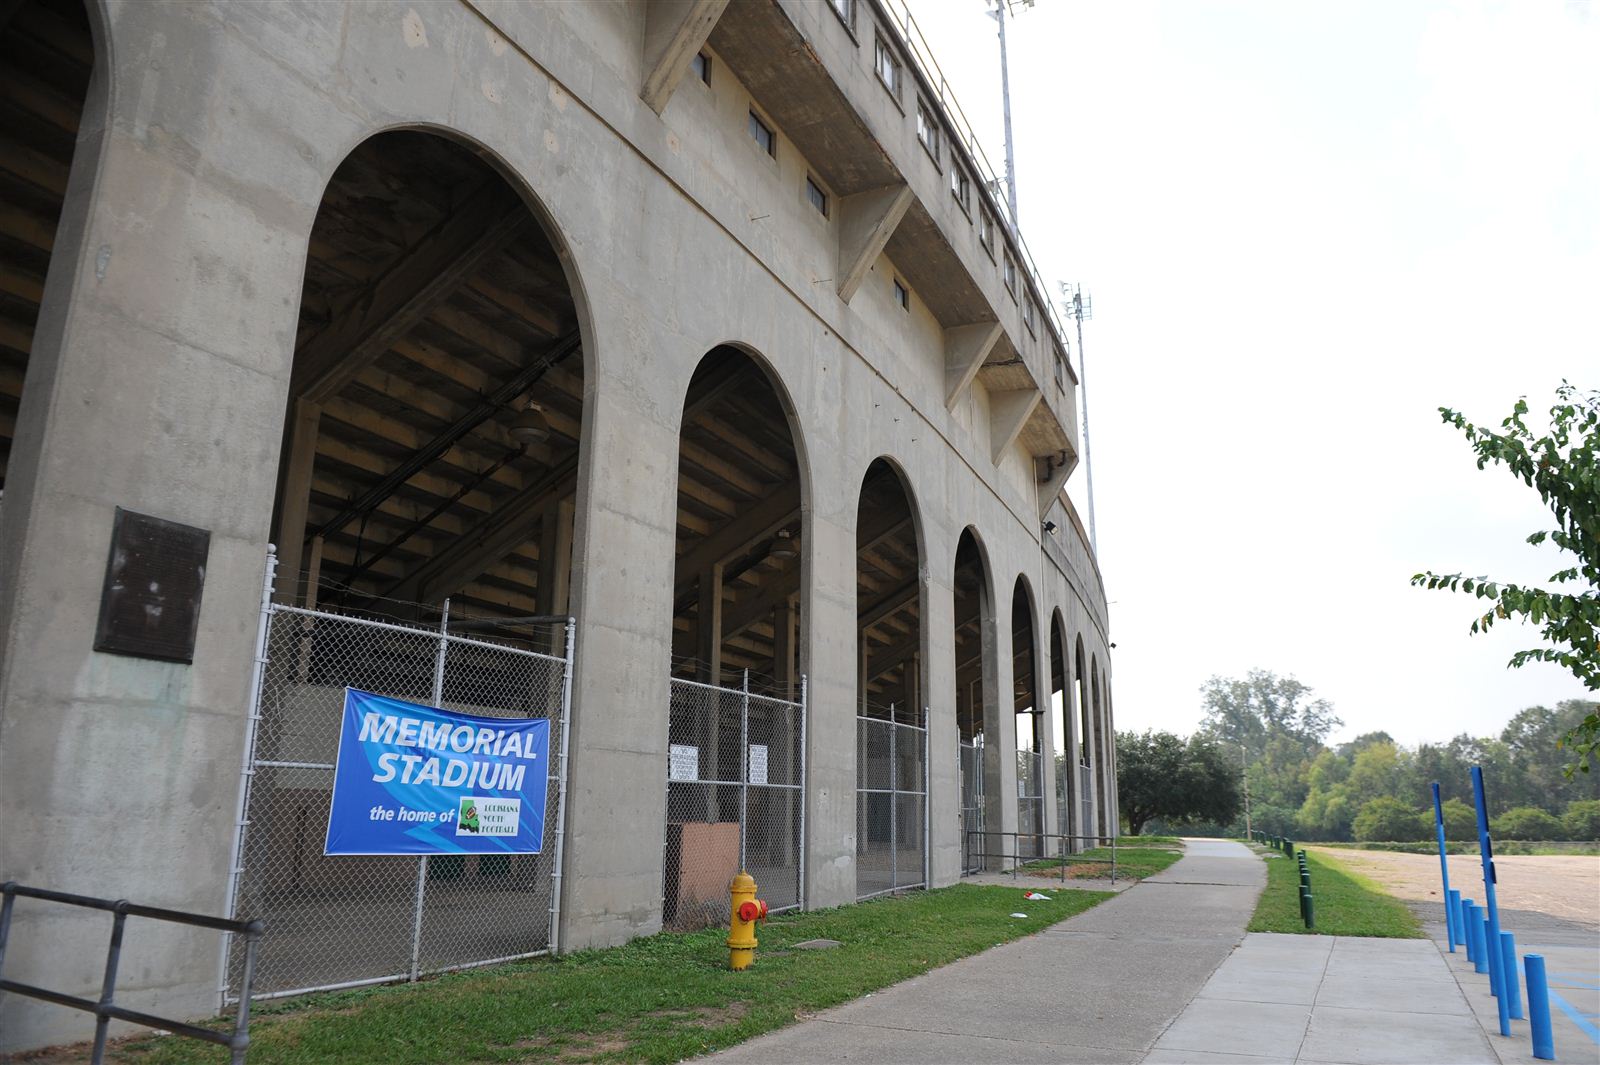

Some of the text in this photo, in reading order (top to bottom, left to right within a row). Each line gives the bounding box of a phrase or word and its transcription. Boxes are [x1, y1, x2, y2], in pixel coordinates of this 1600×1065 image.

[358, 712, 537, 759] MEMORIAL
[372, 752, 526, 791] STADIUM
[369, 805, 455, 823] the home of
[484, 804, 519, 813] LOUISIANA
[483, 815, 505, 823] YOUTH
[481, 825, 516, 834] FOOTBALL
